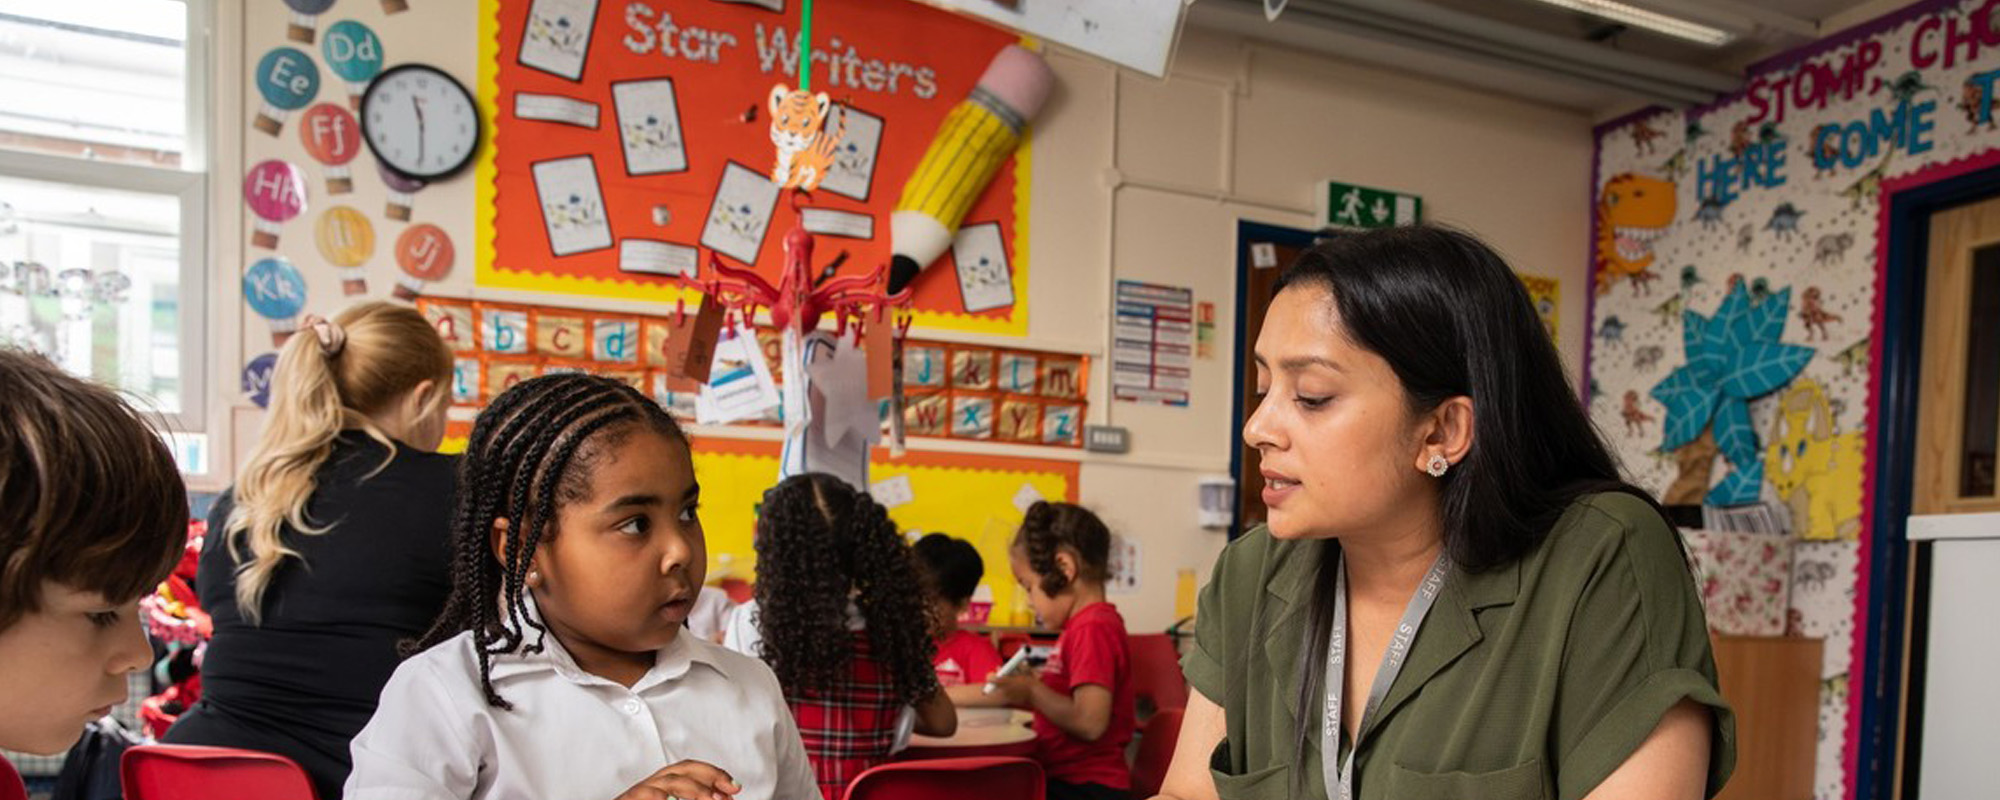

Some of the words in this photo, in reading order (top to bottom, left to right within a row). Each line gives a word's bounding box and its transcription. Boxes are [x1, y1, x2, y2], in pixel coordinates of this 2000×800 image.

[328, 32, 377, 63] Dd
[624, 2, 737, 63] Star
[269, 55, 310, 95] Ee
[1746, 40, 1882, 126] STOMP,
[312, 114, 345, 156] Ff
[1696, 140, 1787, 207] HERE
[1813, 98, 1937, 170] COME
[254, 167, 300, 208] Hh
[408, 233, 440, 271] Jj
[252, 272, 298, 300] Kk
[494, 315, 514, 350] b
[552, 327, 571, 351] c
[606, 322, 625, 358] d
[964, 352, 982, 384] k
[1049, 366, 1076, 393] m
[1421, 557, 1447, 600] STAFF
[1389, 622, 1413, 668] STAFF
[1325, 693, 1338, 738] STAFF
